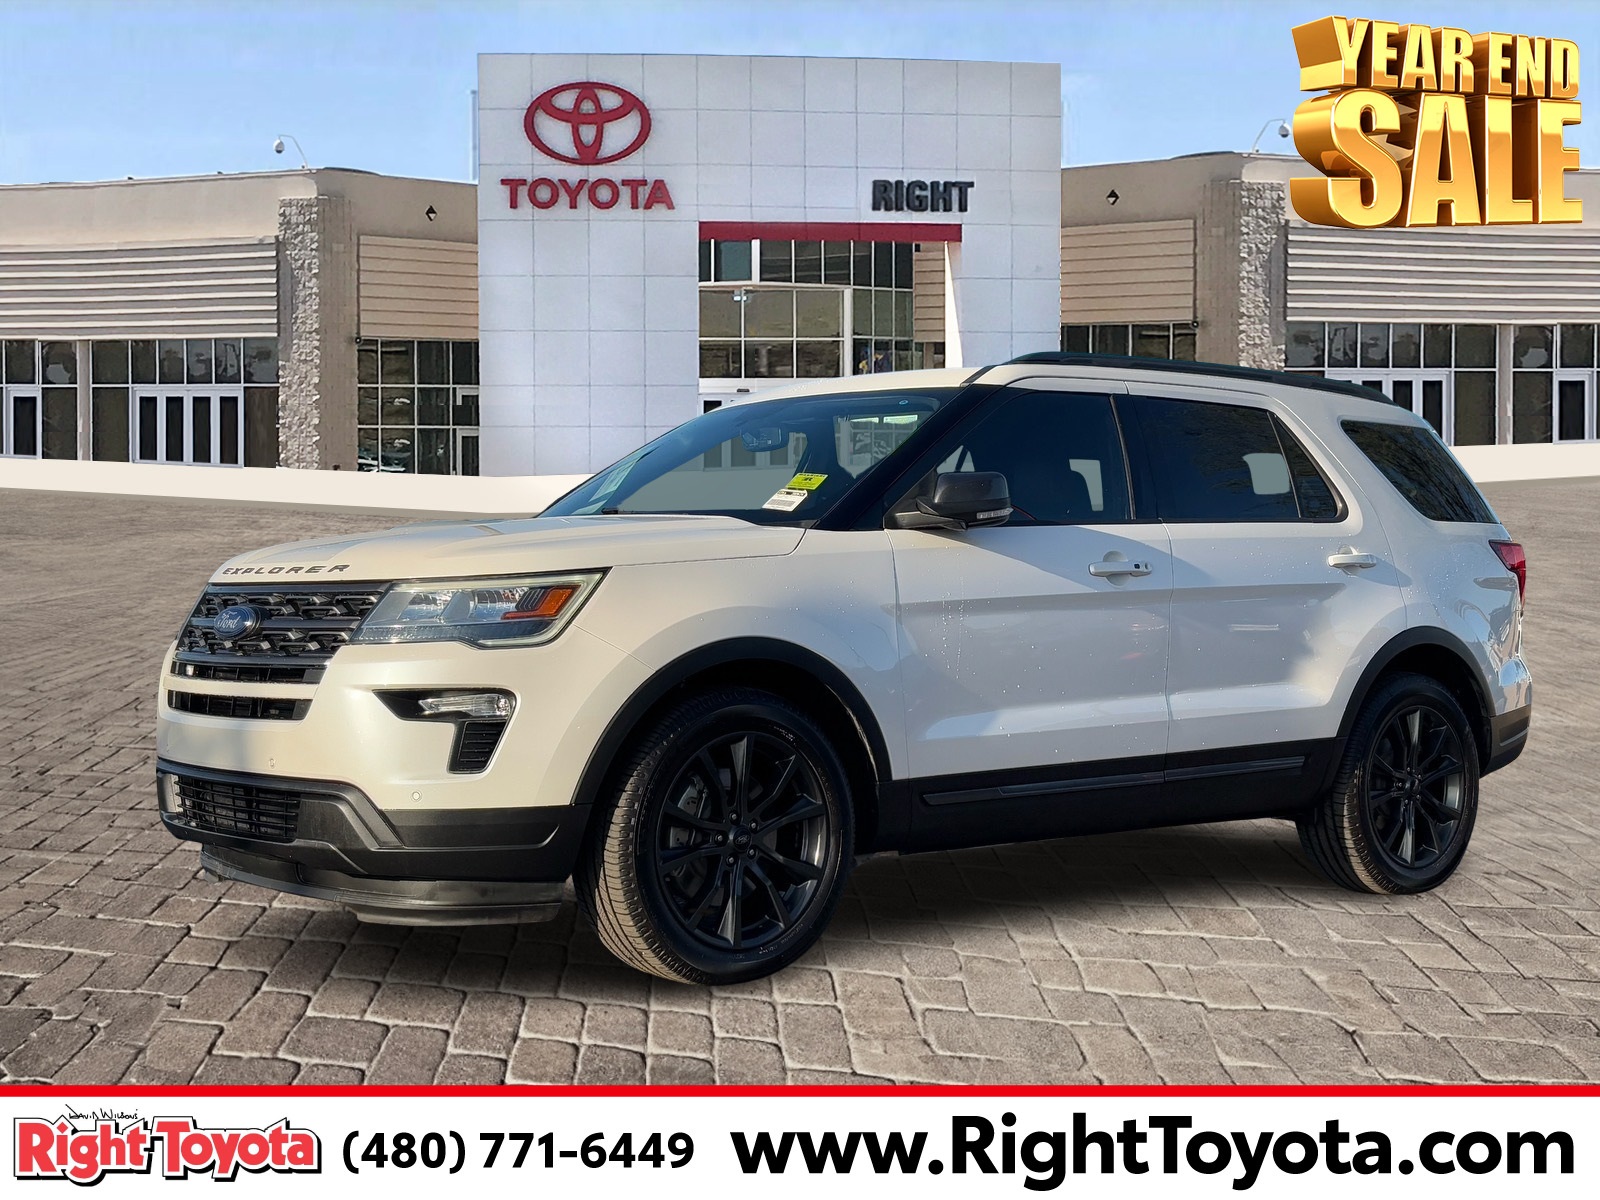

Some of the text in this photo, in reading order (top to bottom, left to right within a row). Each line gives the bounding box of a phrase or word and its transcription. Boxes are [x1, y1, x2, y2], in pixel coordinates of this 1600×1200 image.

[500, 178, 676, 211] TOYOTA
[871, 178, 977, 213] RIGHT
[222, 564, 351, 575] EXPLORER
[219, 611, 241, 629] Ford
